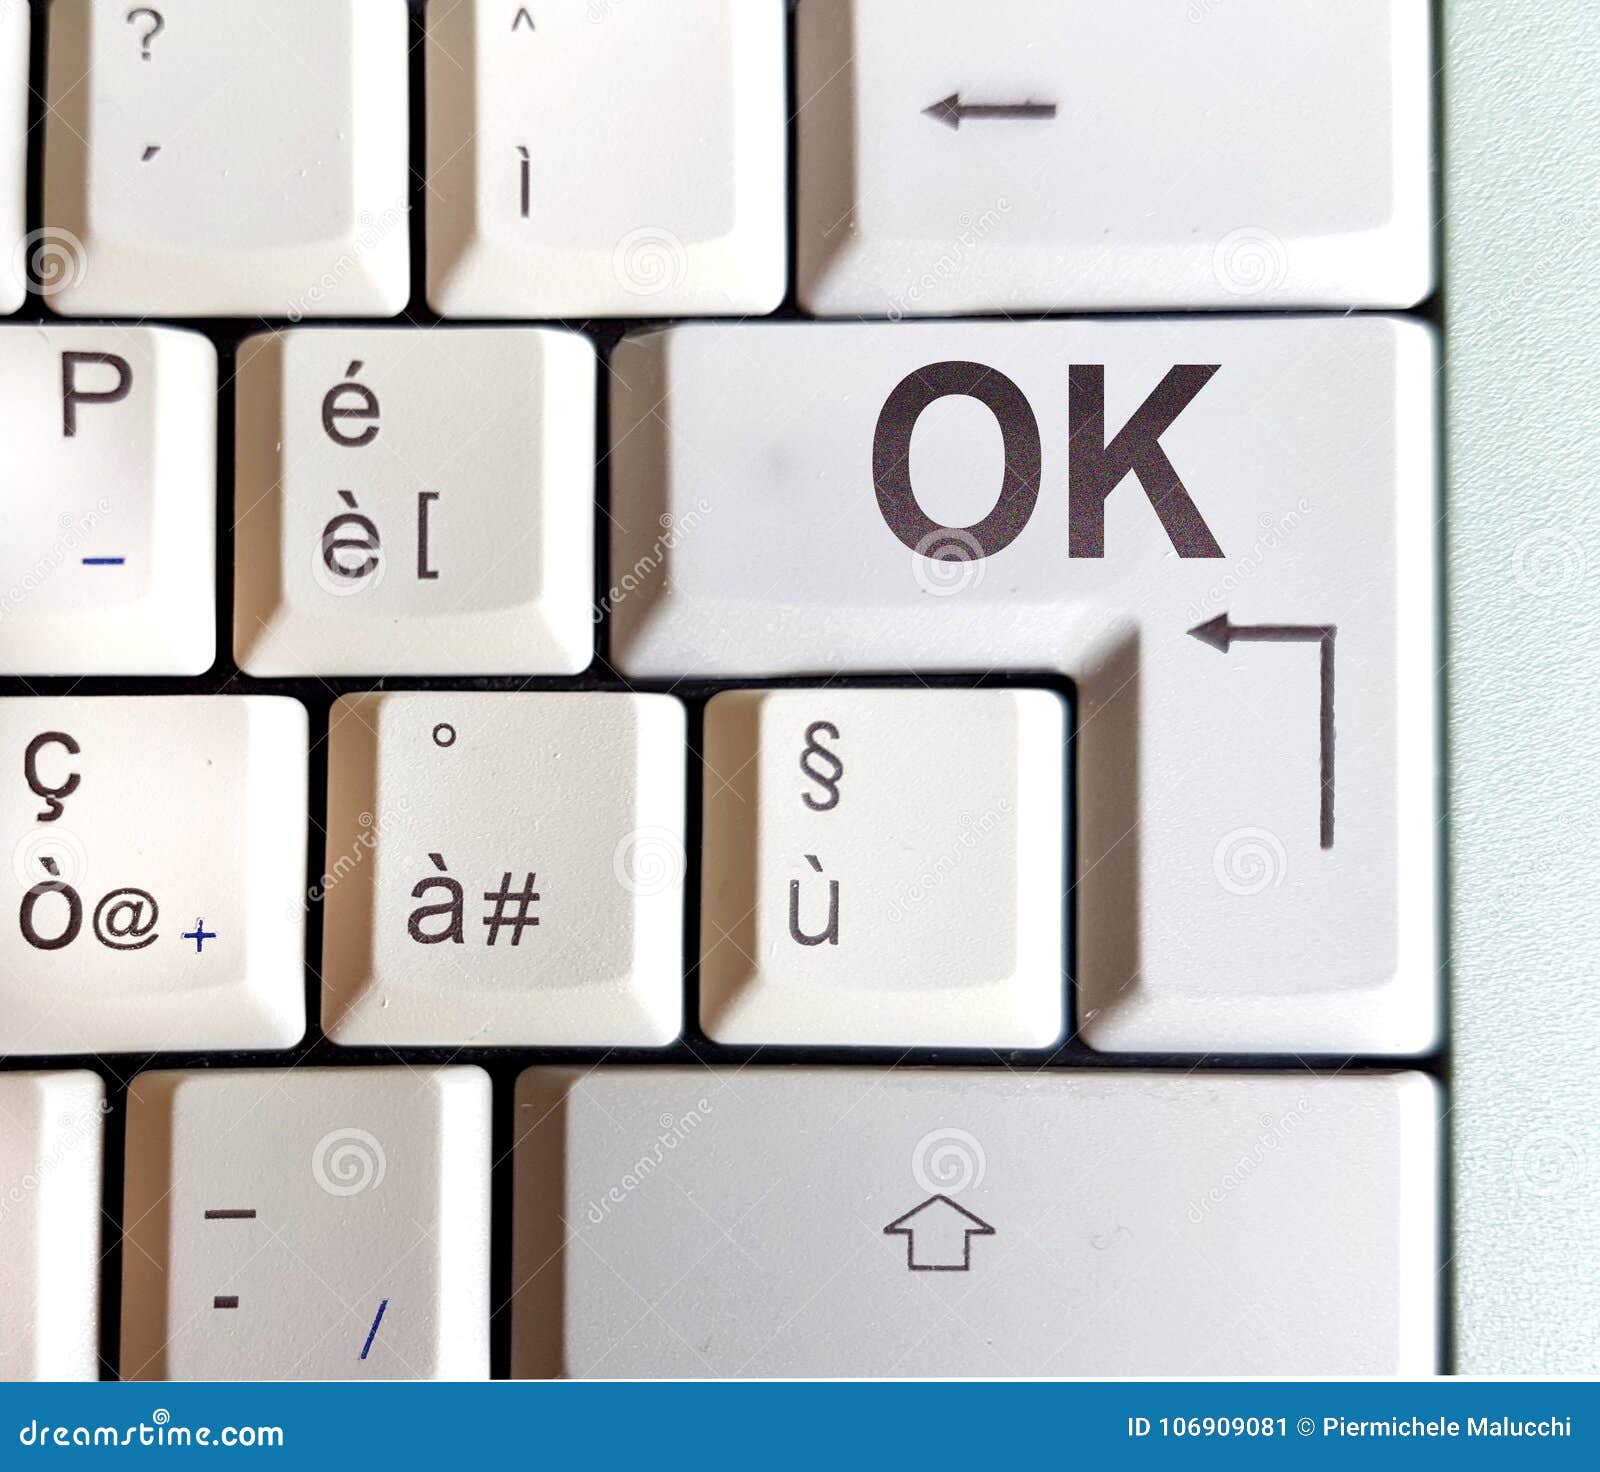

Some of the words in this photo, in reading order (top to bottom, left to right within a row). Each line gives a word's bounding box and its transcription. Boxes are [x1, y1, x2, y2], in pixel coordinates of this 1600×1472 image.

[126, 7, 165, 61] ?
[511, 7, 536, 31] ^
[515, 145, 530, 218] ì
[60, 350, 134, 438] P
[320, 359, 381, 448] é
[871, 360, 1226, 562] OK
[320, 489, 381, 580] è
[416, 491, 440, 580] [
[799, 720, 844, 812] §
[182, 918, 217, 953] +
[482, 871, 541, 947] #
[788, 854, 840, 947] ù
[358, 1299, 389, 1360] /
